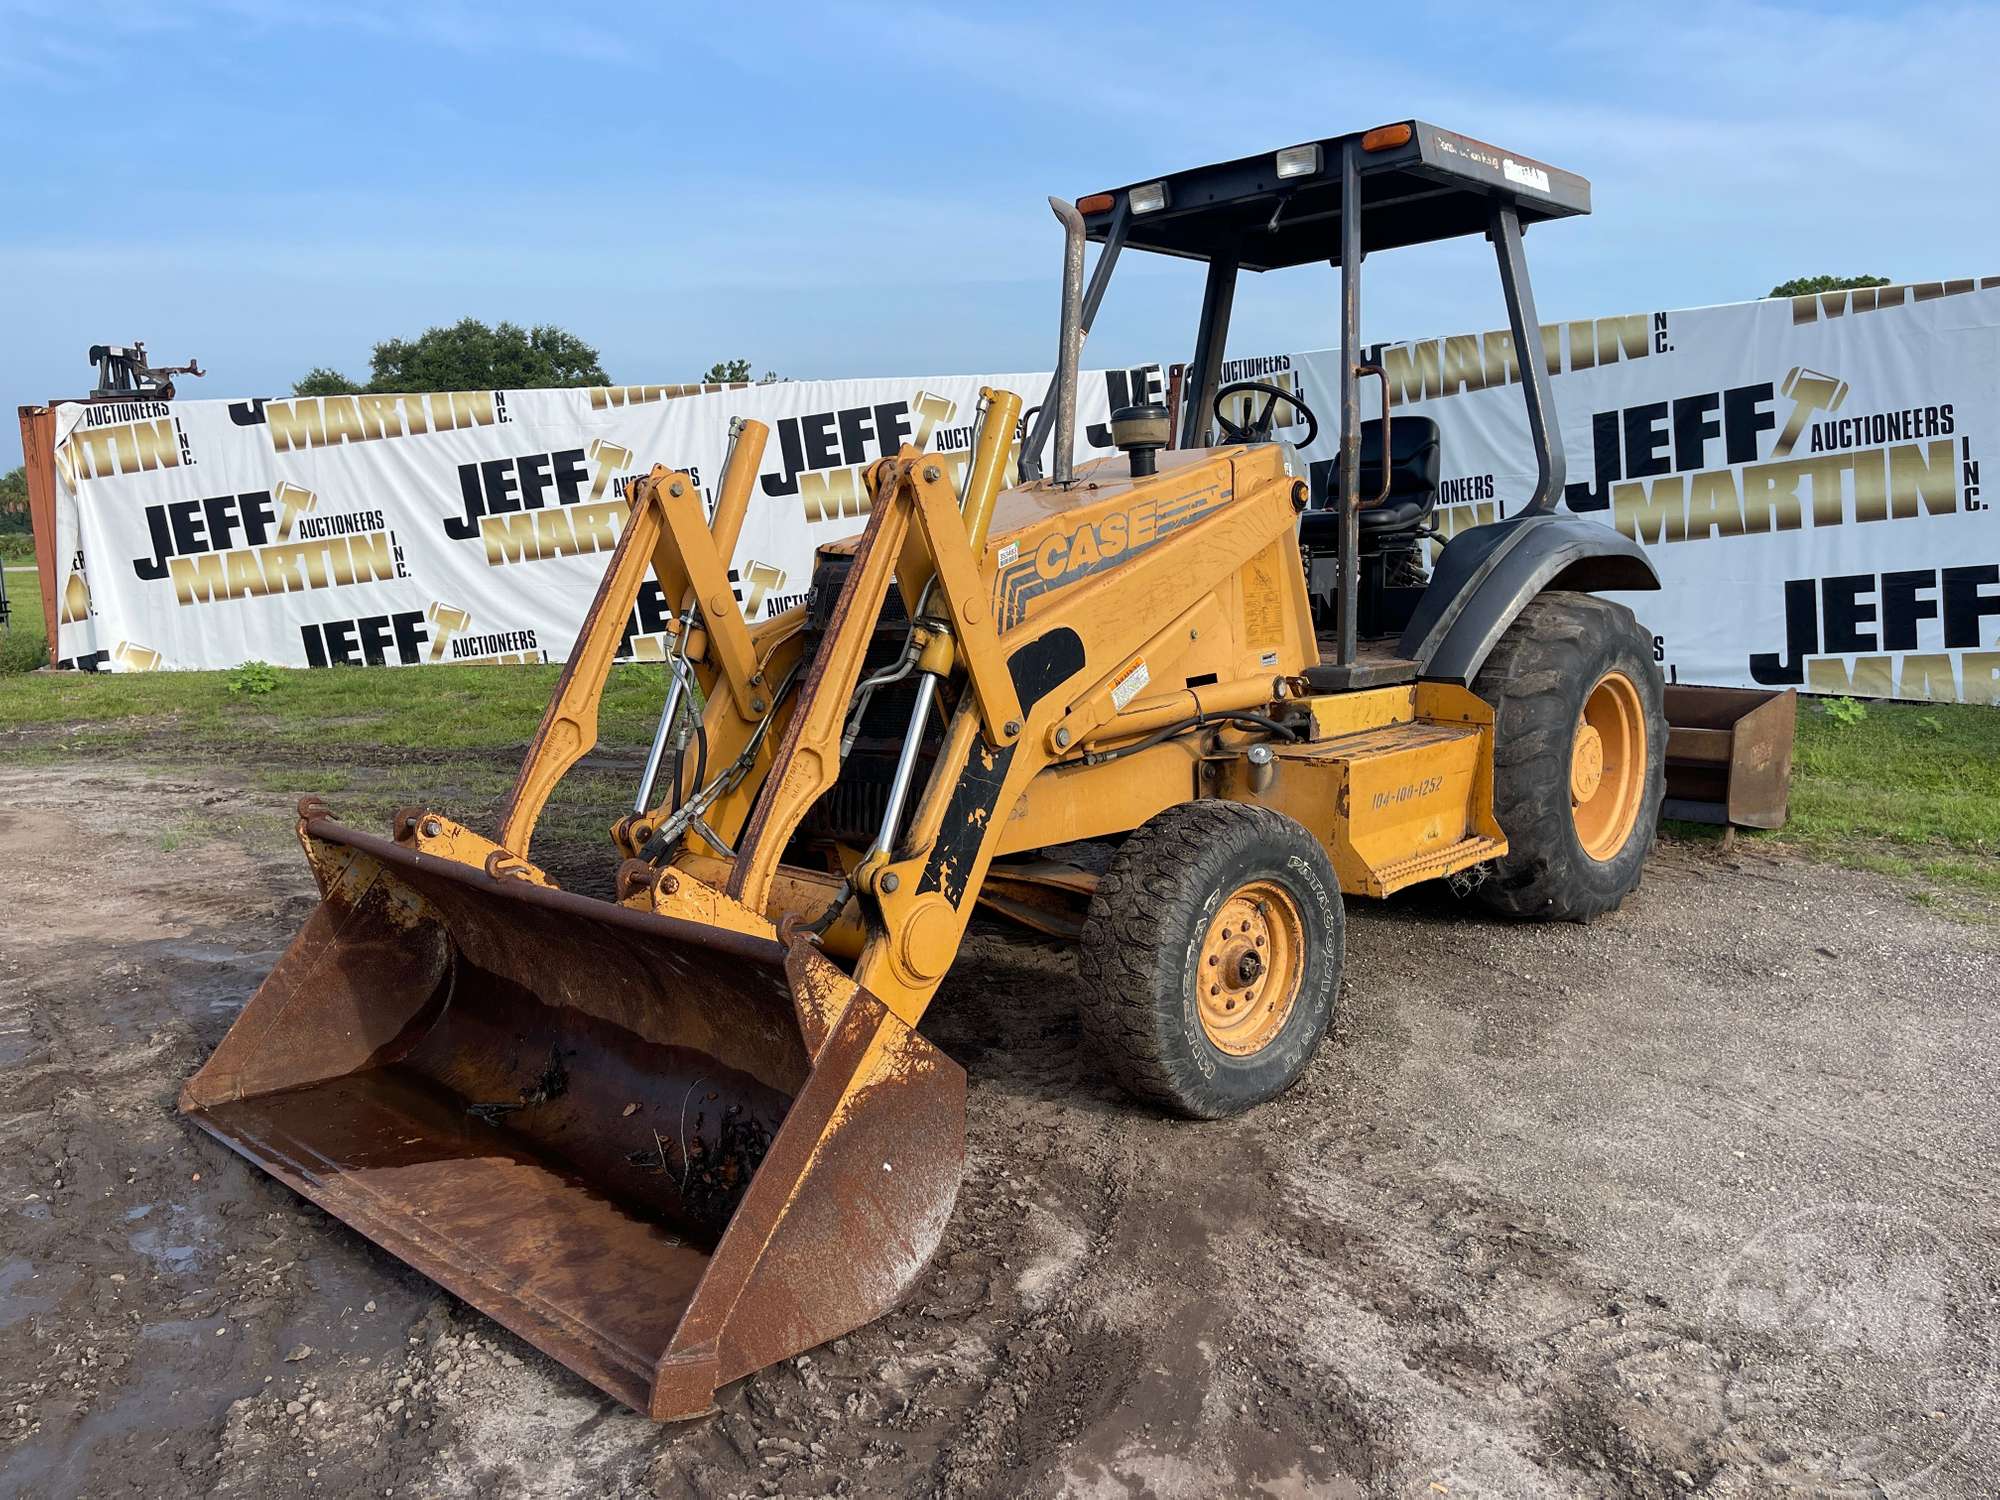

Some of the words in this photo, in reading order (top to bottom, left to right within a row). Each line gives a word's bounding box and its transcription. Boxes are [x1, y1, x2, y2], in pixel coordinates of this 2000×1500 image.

[1654, 312, 1674, 353] NC.
[1219, 355, 1290, 384] UCTIONEERS
[86, 402, 169, 427] AUCTIONEERS
[264, 390, 494, 453] MARTIN
[495, 391, 512, 423] NC.
[1811, 404, 1954, 452] AUCTIONEERS
[760, 401, 911, 497] JEFF
[1565, 382, 1775, 512] JEFF
[1962, 436, 1988, 512] INC.
[299, 510, 385, 540] AUCTIONEERS
[443, 448, 589, 540] JEFF
[1613, 439, 1957, 545] MARTIN
[133, 490, 275, 581] JEFF
[390, 530, 411, 578] INC.
[481, 500, 632, 567] MAR
[1035, 499, 1157, 579] CASE
[169, 532, 394, 607] MARTIN
[452, 629, 537, 658] AUCTIONEERS
[1749, 564, 2000, 686] JEFF
[1372, 775, 1443, 810] 104-100-1252
[1288, 855, 1335, 1014] PATAGONIA
